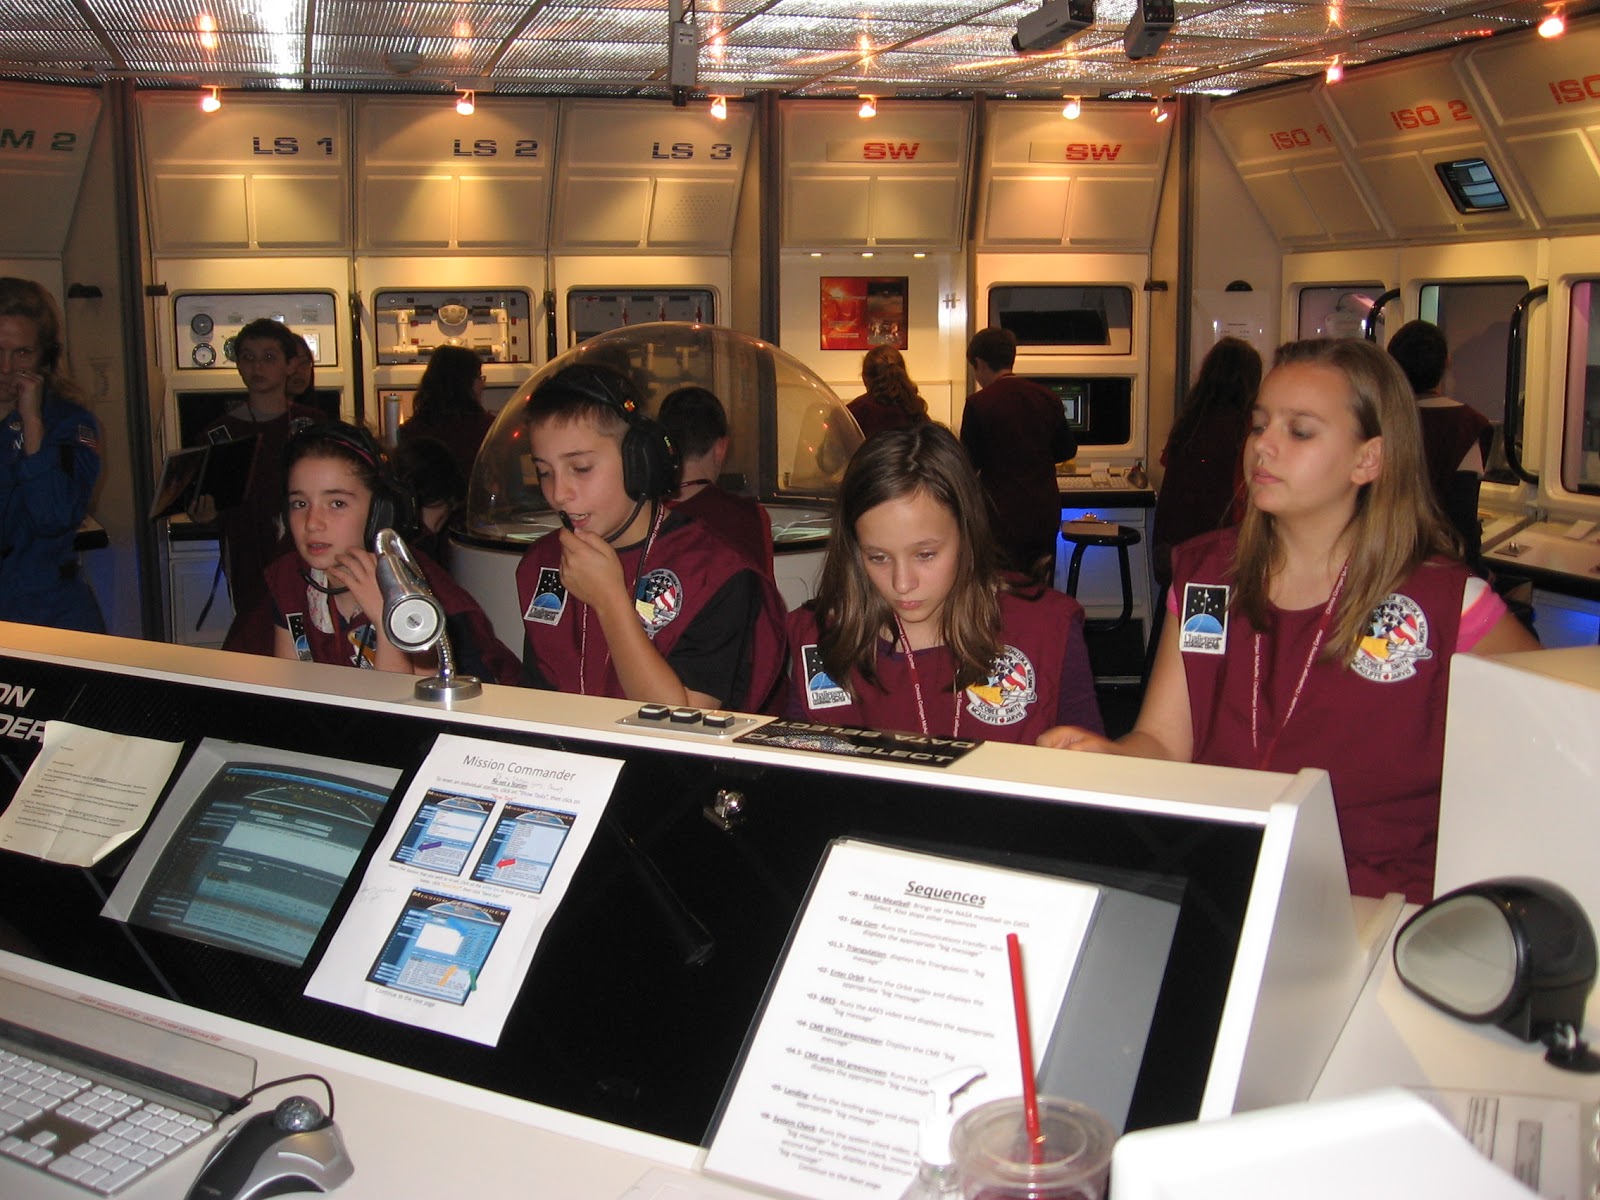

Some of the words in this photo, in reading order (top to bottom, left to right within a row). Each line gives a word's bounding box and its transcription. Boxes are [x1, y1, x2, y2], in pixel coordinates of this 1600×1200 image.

[1548, 75, 1600, 105] ISO
[1390, 105, 1440, 130] ISO
[1447, 99, 1473, 122] 2
[51, 132, 77, 151] 2
[252, 137, 299, 155] LS
[316, 137, 332, 155] 1
[1269, 128, 1312, 150] ISO
[1317, 123, 1331, 142] 1
[453, 139, 497, 157] LS
[514, 140, 538, 157] 2
[651, 142, 694, 160] LS
[710, 143, 732, 160] 3
[863, 142, 920, 160] SW
[1065, 143, 1122, 161] SW
[462, 755, 504, 771] Mission
[507, 762, 577, 781] Commander
[904, 880, 987, 908] Sequences
